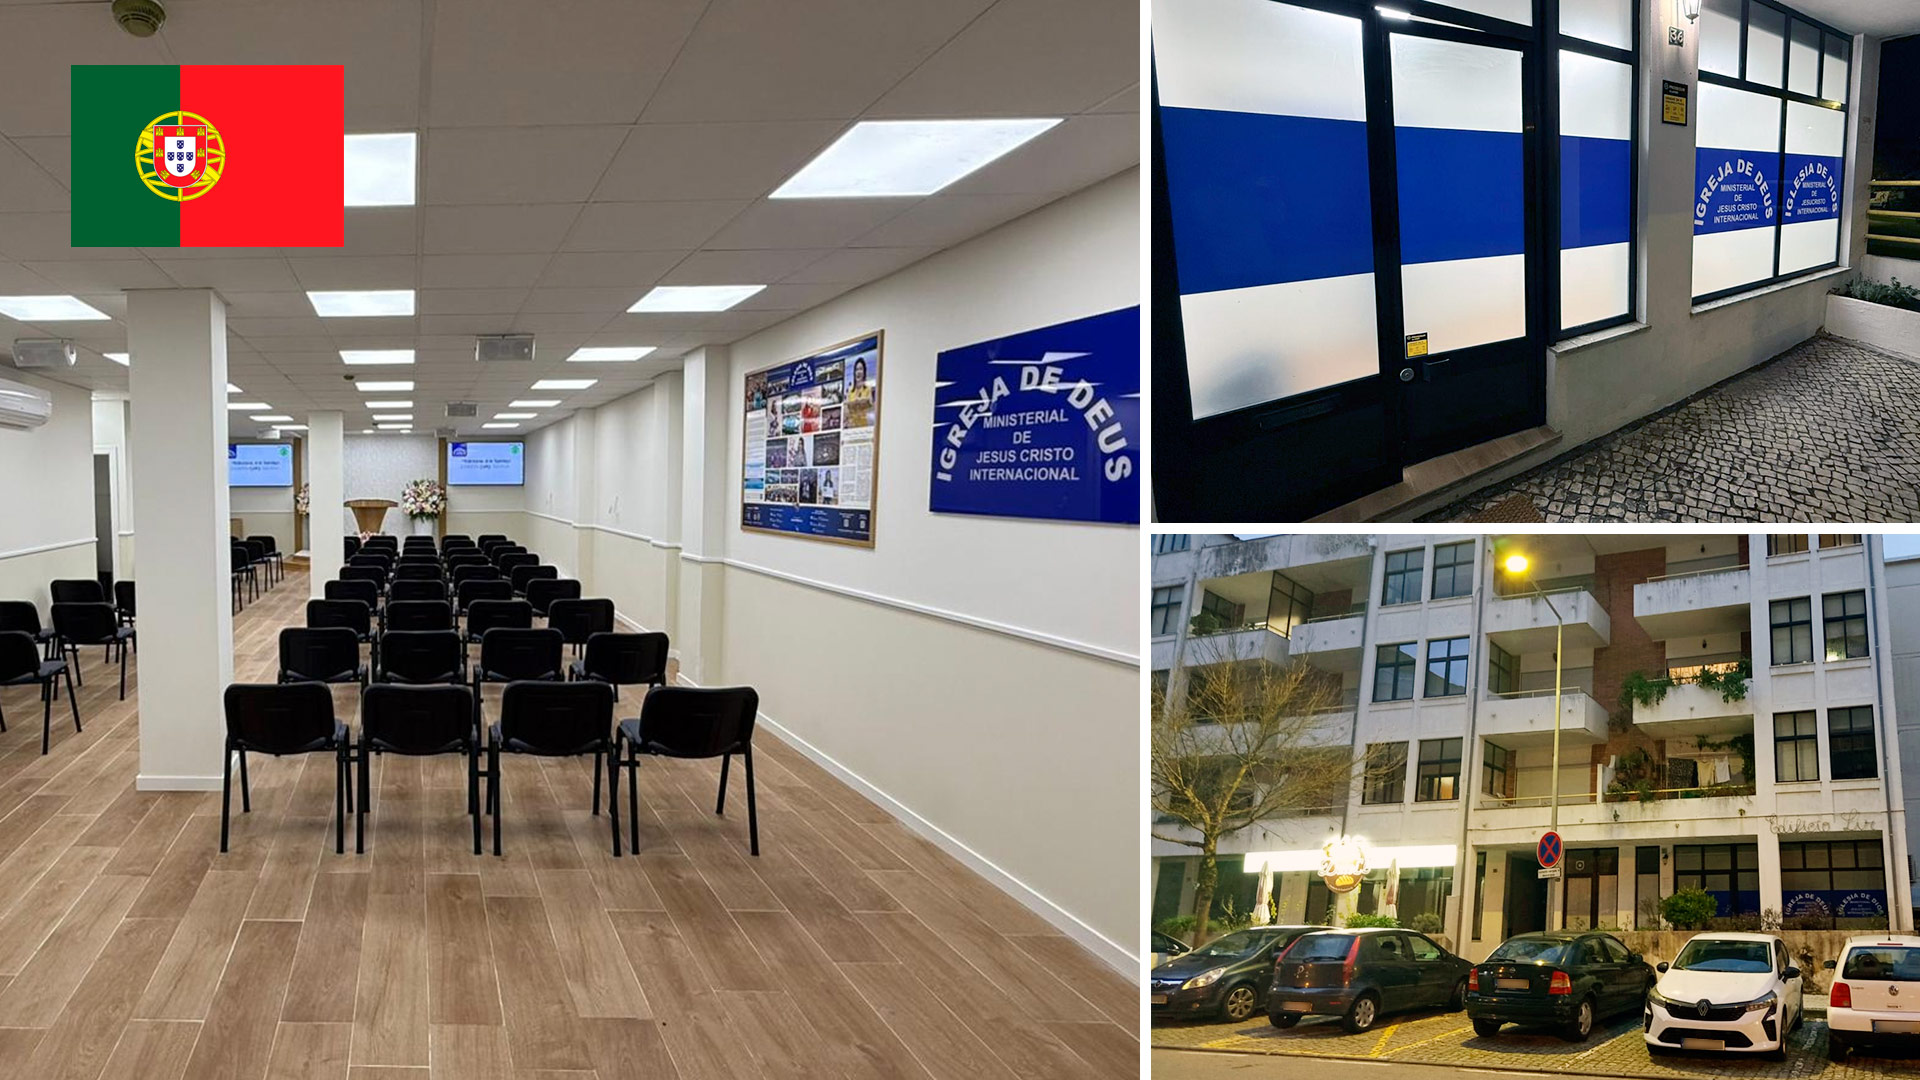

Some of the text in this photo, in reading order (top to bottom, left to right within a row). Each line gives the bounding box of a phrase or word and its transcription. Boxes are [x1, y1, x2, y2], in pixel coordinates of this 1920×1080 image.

[1720, 184, 1755, 192] MINISTERIAL
[1785, 163, 1838, 217] IGLESIA DE DIOS
[1802, 181, 1827, 189] MINISTERIAL
[1694, 158, 1773, 226] IGREJA DE DEUS
[1801, 198, 1826, 206] JESUCRISTO
[1717, 203, 1757, 213] JESUS CRISTO
[1797, 207, 1828, 215] INTERNACIONAL
[1713, 213, 1759, 224] INTERNACIONAL
[936, 376, 1010, 482] IGREJA
[1020, 366, 1064, 394] DE
[1067, 378, 1132, 482] DEUS
[983, 409, 1069, 428] MINISTERIAL
[1013, 431, 1032, 444] DE
[976, 447, 1074, 463] JESUS CRISTO
[969, 467, 1080, 481] INTERNACIONAL
[1804, 892, 1815, 900] DE
[1860, 892, 1871, 900] DE
